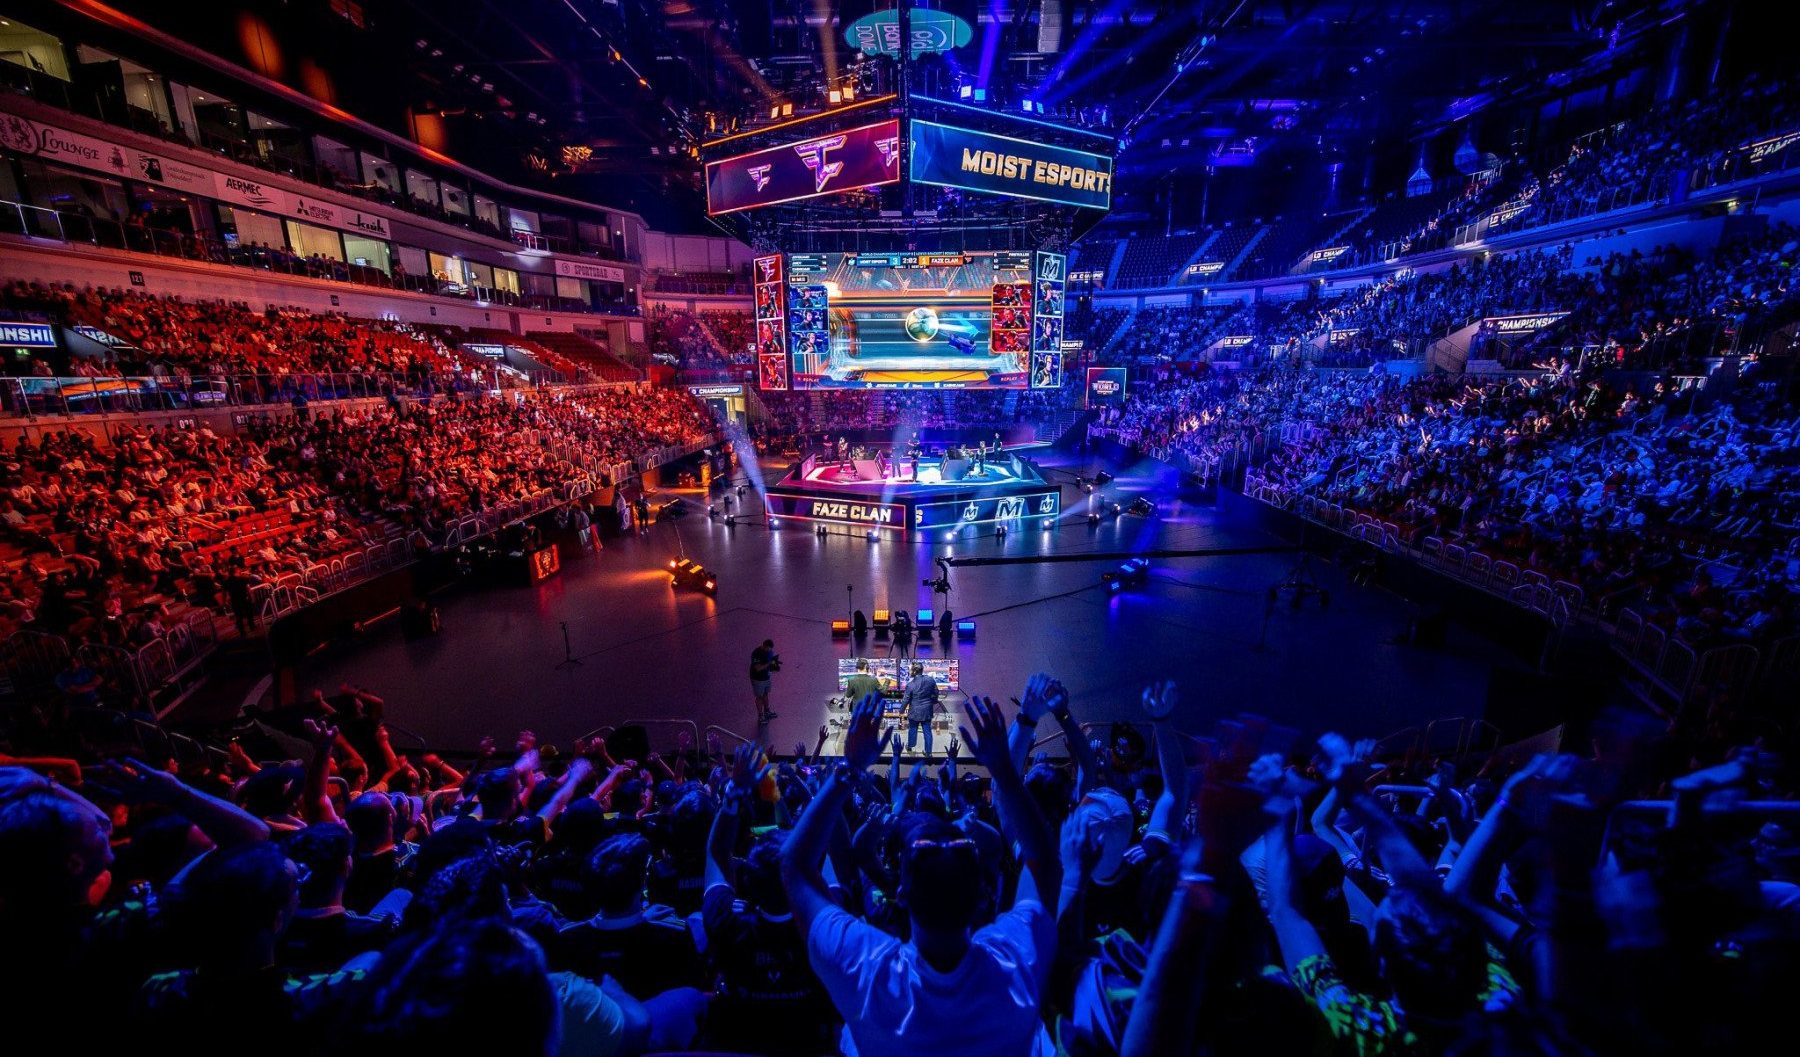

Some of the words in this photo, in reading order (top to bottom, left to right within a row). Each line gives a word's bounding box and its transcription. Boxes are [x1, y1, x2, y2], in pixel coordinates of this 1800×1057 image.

[856, 25, 877, 51] DOME
[961, 147, 1032, 180] MOIST
[225, 177, 263, 197] AERMEC
[893, 257, 898, 265] 3
[699, 387, 740, 395] CHAMPIONSHIP
[812, 502, 847, 520] FAZE
[850, 504, 892, 522] CLAN
